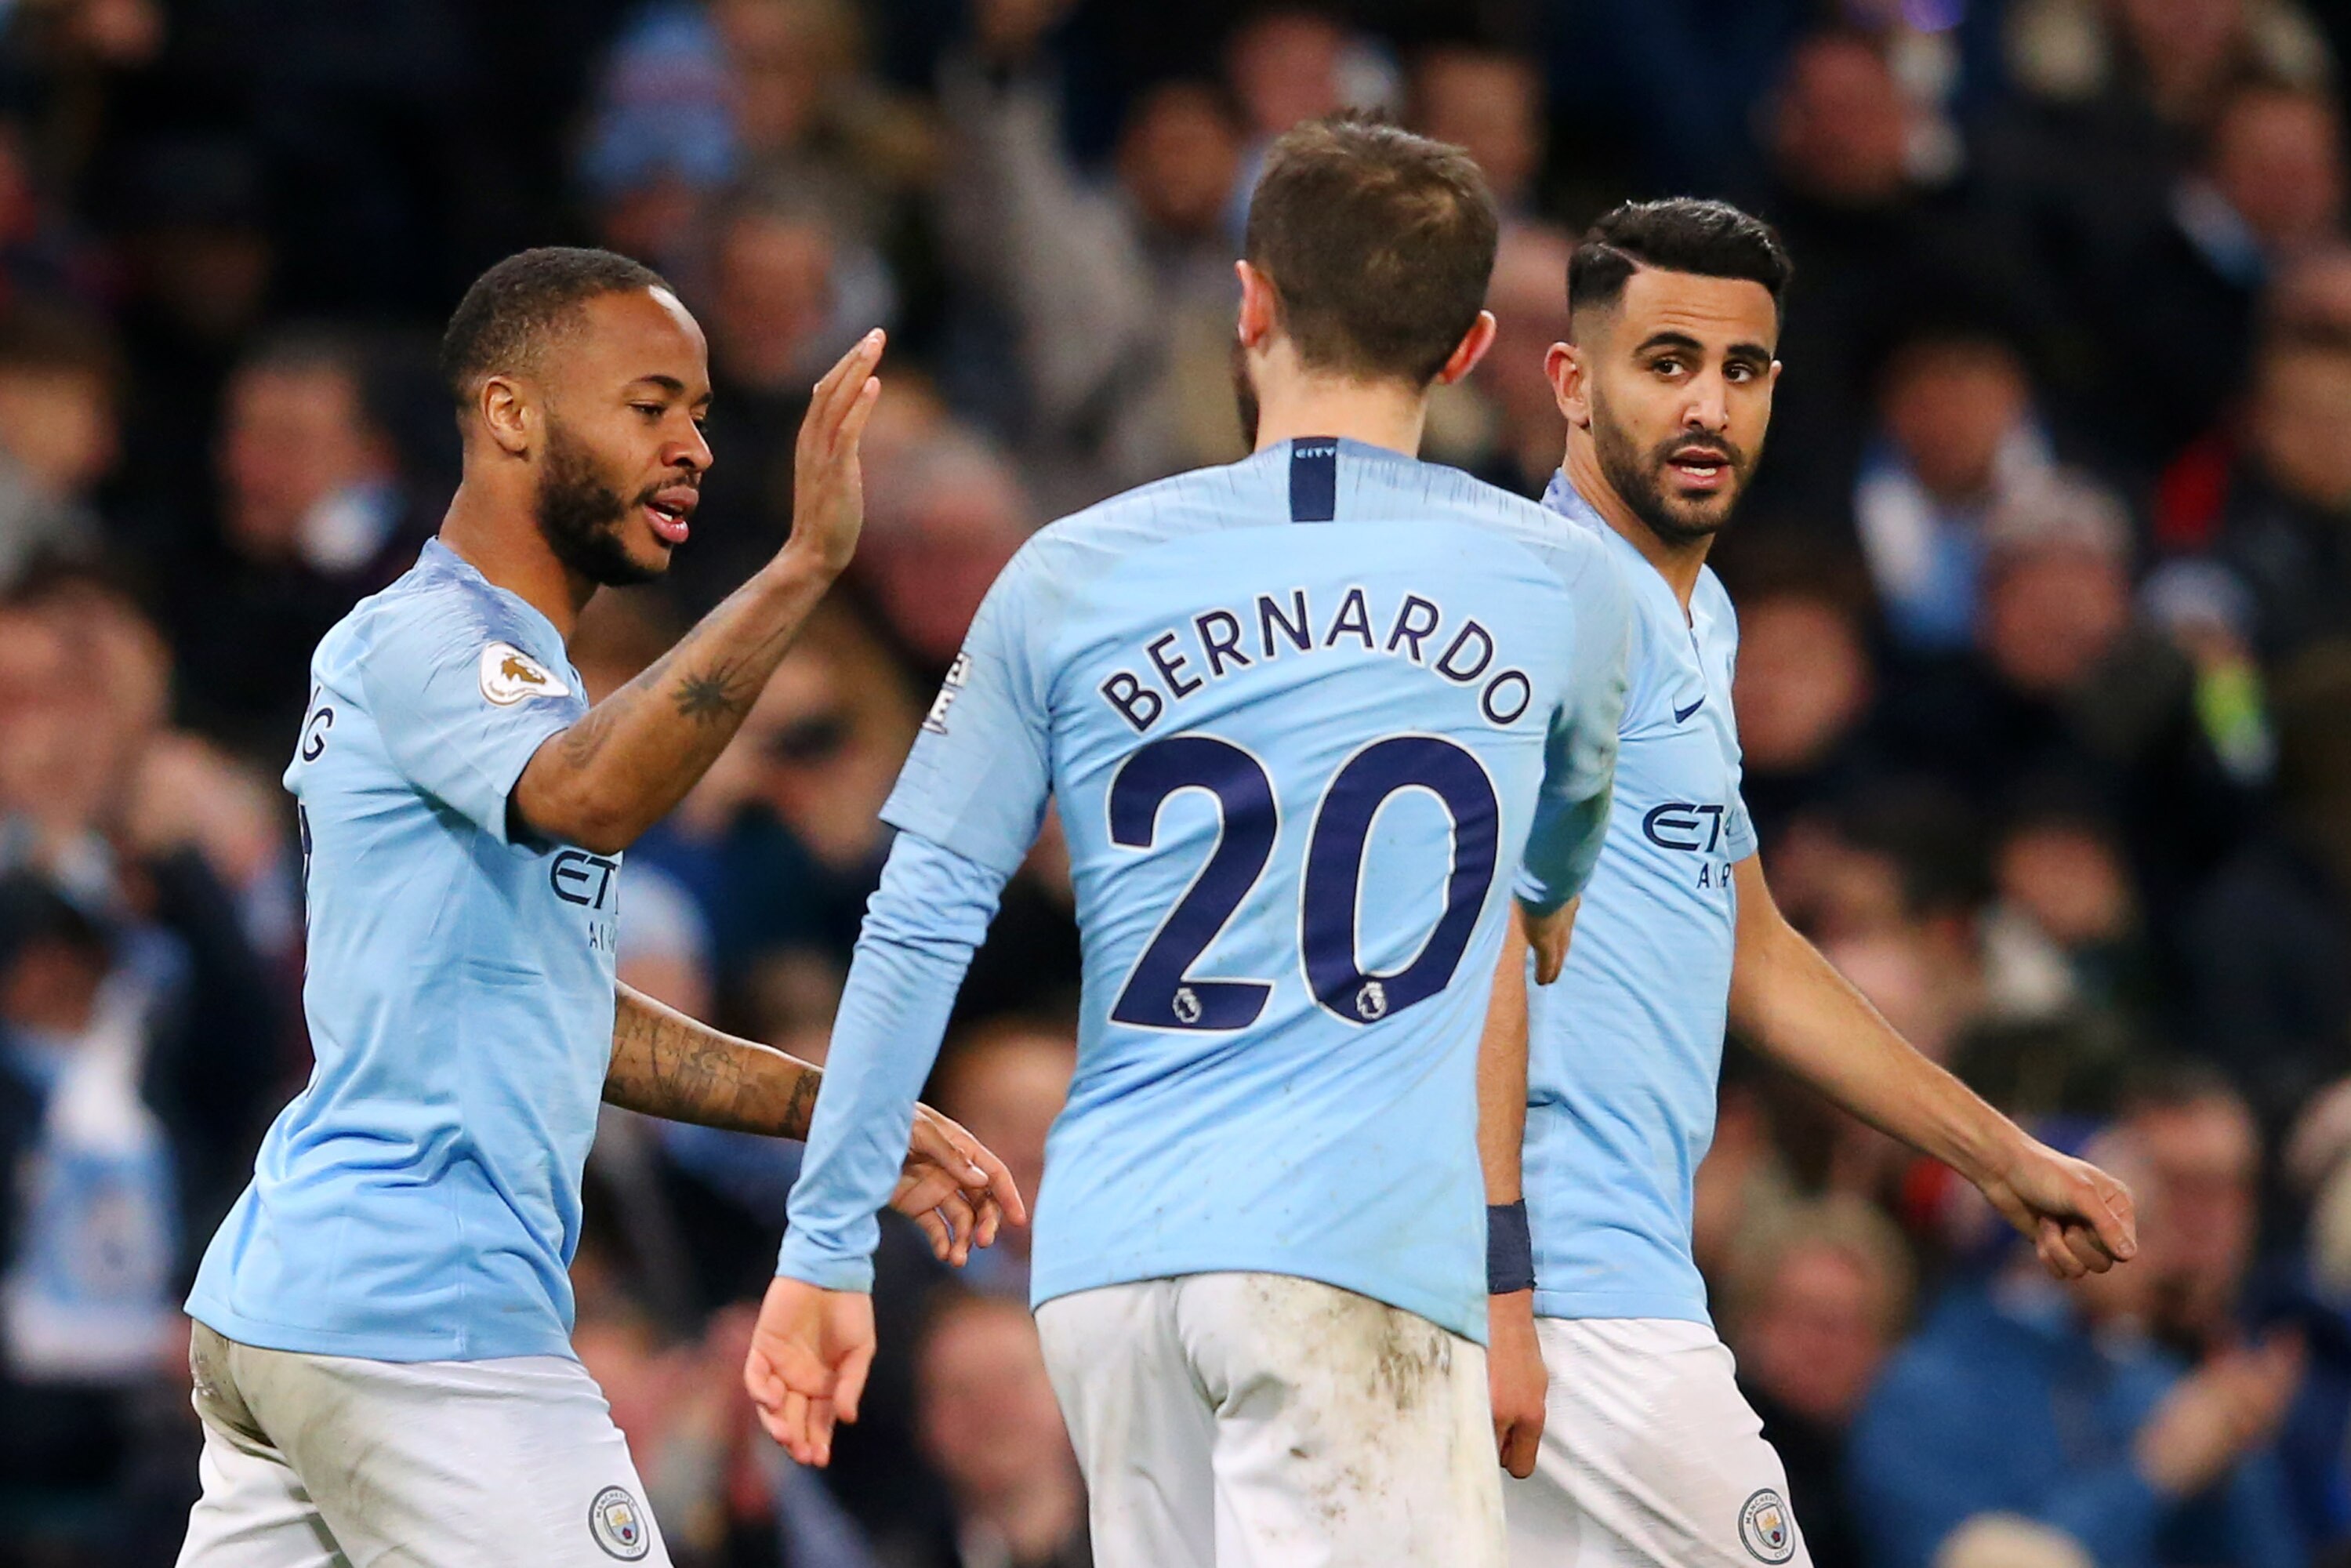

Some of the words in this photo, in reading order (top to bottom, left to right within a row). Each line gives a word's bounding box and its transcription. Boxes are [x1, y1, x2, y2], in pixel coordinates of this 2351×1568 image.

[1295, 446, 1336, 459] CITY
[1101, 586, 1531, 733] BERNARDO
[1642, 803, 1725, 853] ET
[550, 850, 618, 913] ET
[1106, 732, 1499, 1033] 20
